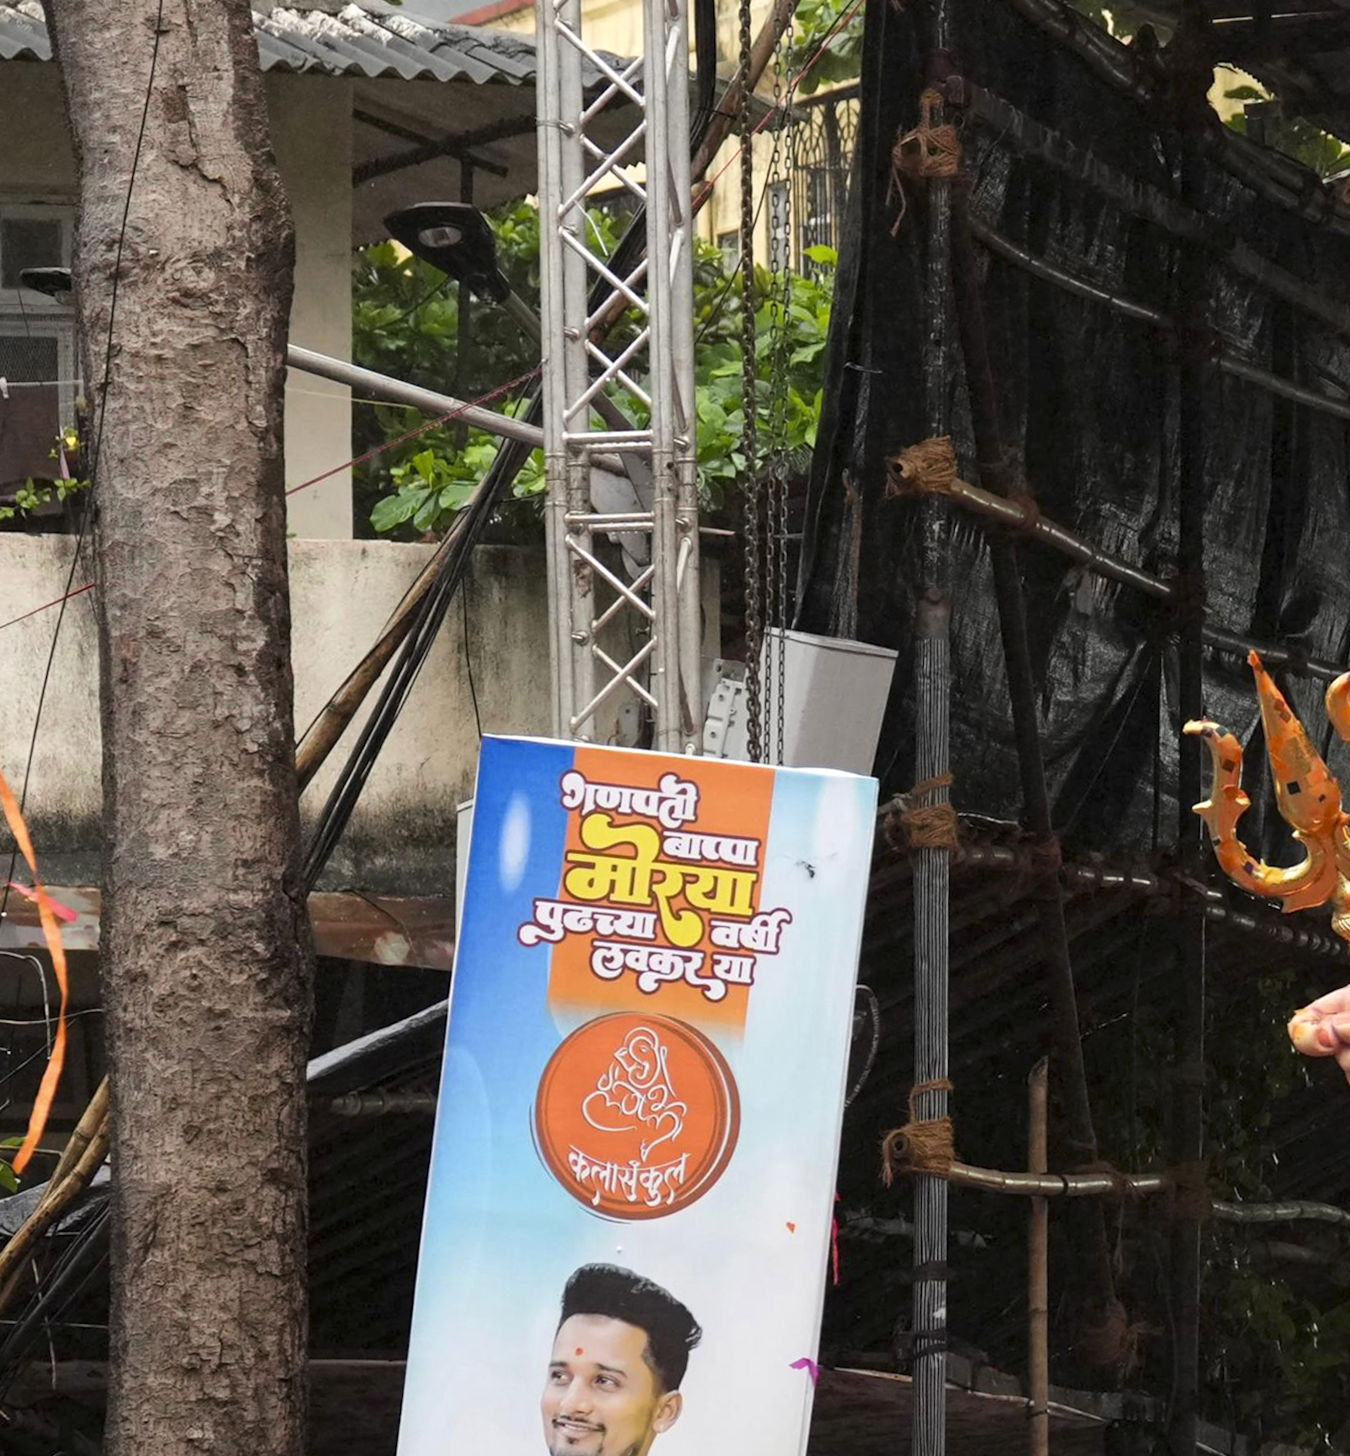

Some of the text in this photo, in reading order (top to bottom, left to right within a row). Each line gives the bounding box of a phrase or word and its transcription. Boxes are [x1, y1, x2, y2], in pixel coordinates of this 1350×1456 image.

[561, 772, 699, 828] गणपती
[662, 831, 760, 866] बाप्पा
[564, 812, 758, 947] मोरया
[519, 900, 792, 954] पुढच्या वर्षी
[590, 941, 756, 1000] लवकर या
